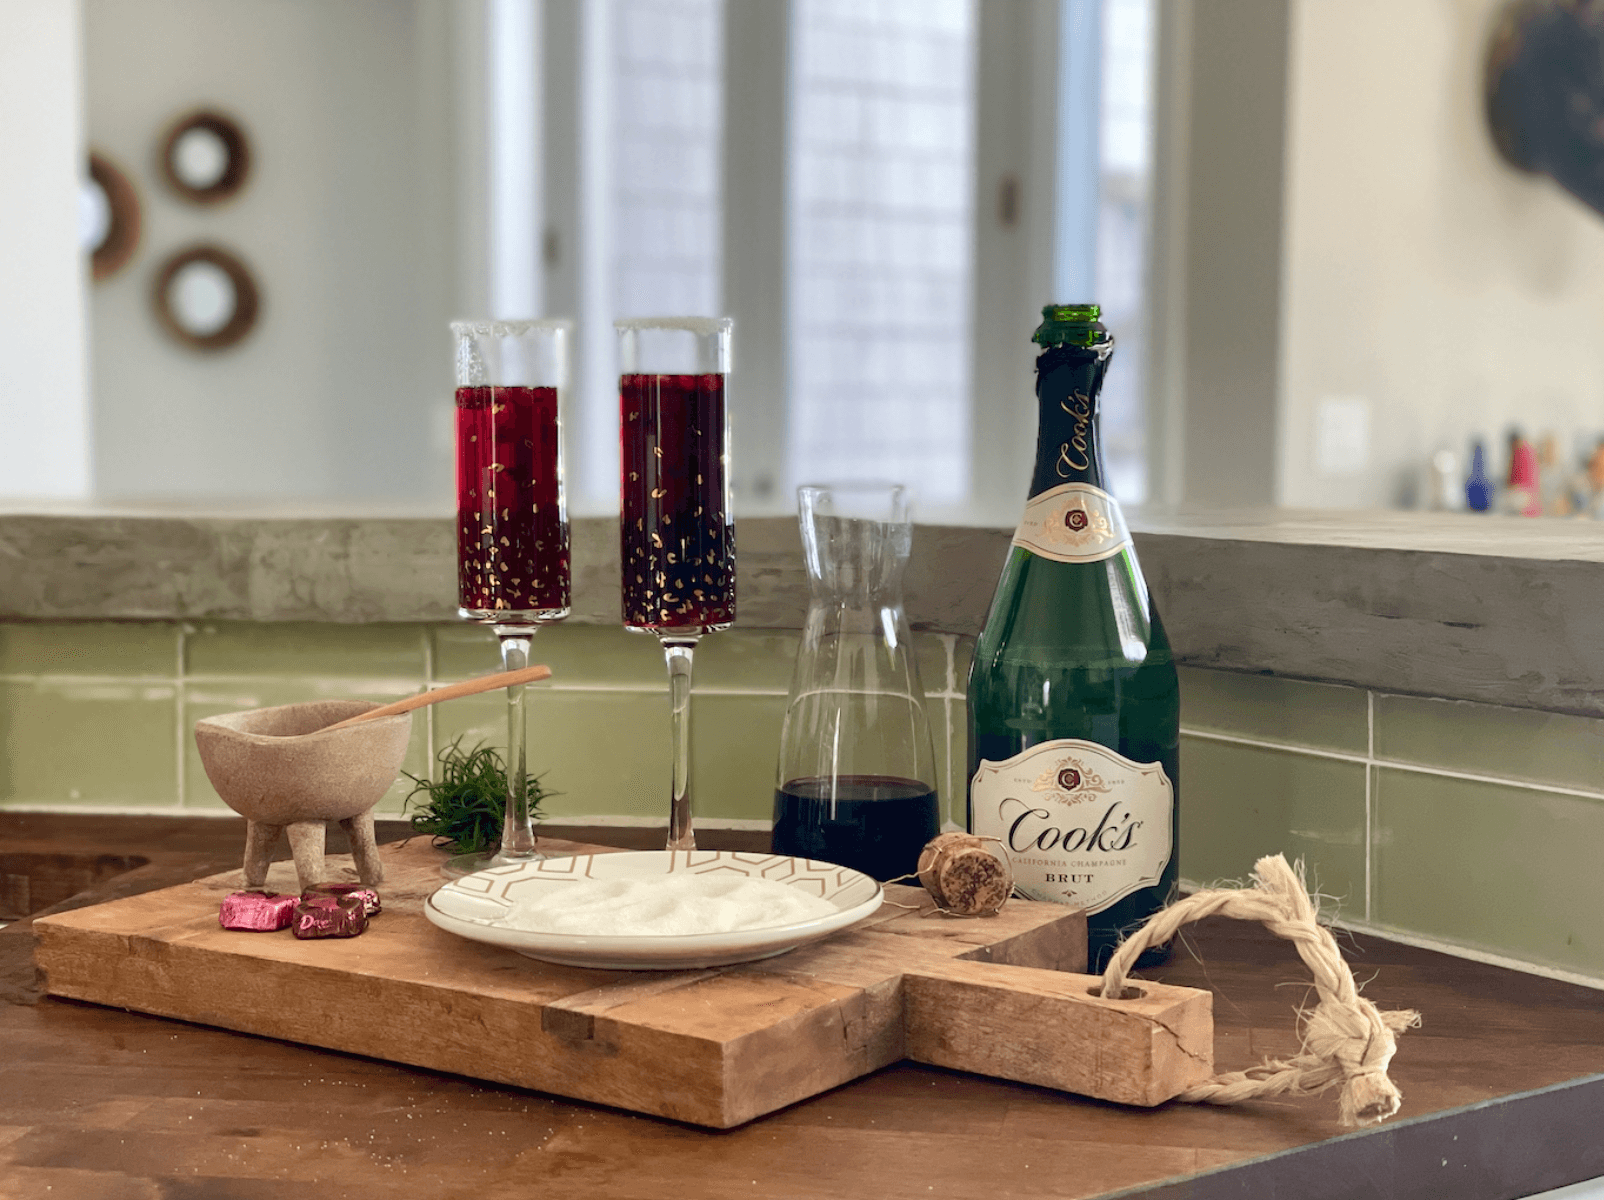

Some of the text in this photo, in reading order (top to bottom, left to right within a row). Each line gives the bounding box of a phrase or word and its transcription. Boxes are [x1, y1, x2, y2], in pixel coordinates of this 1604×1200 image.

[1055, 388, 1091, 478] Cook's
[998, 797, 1144, 854] Cook's
[1012, 856, 1127, 868] CALIFORNIA CHAMPAGNE
[1045, 873, 1094, 883] BRUT
